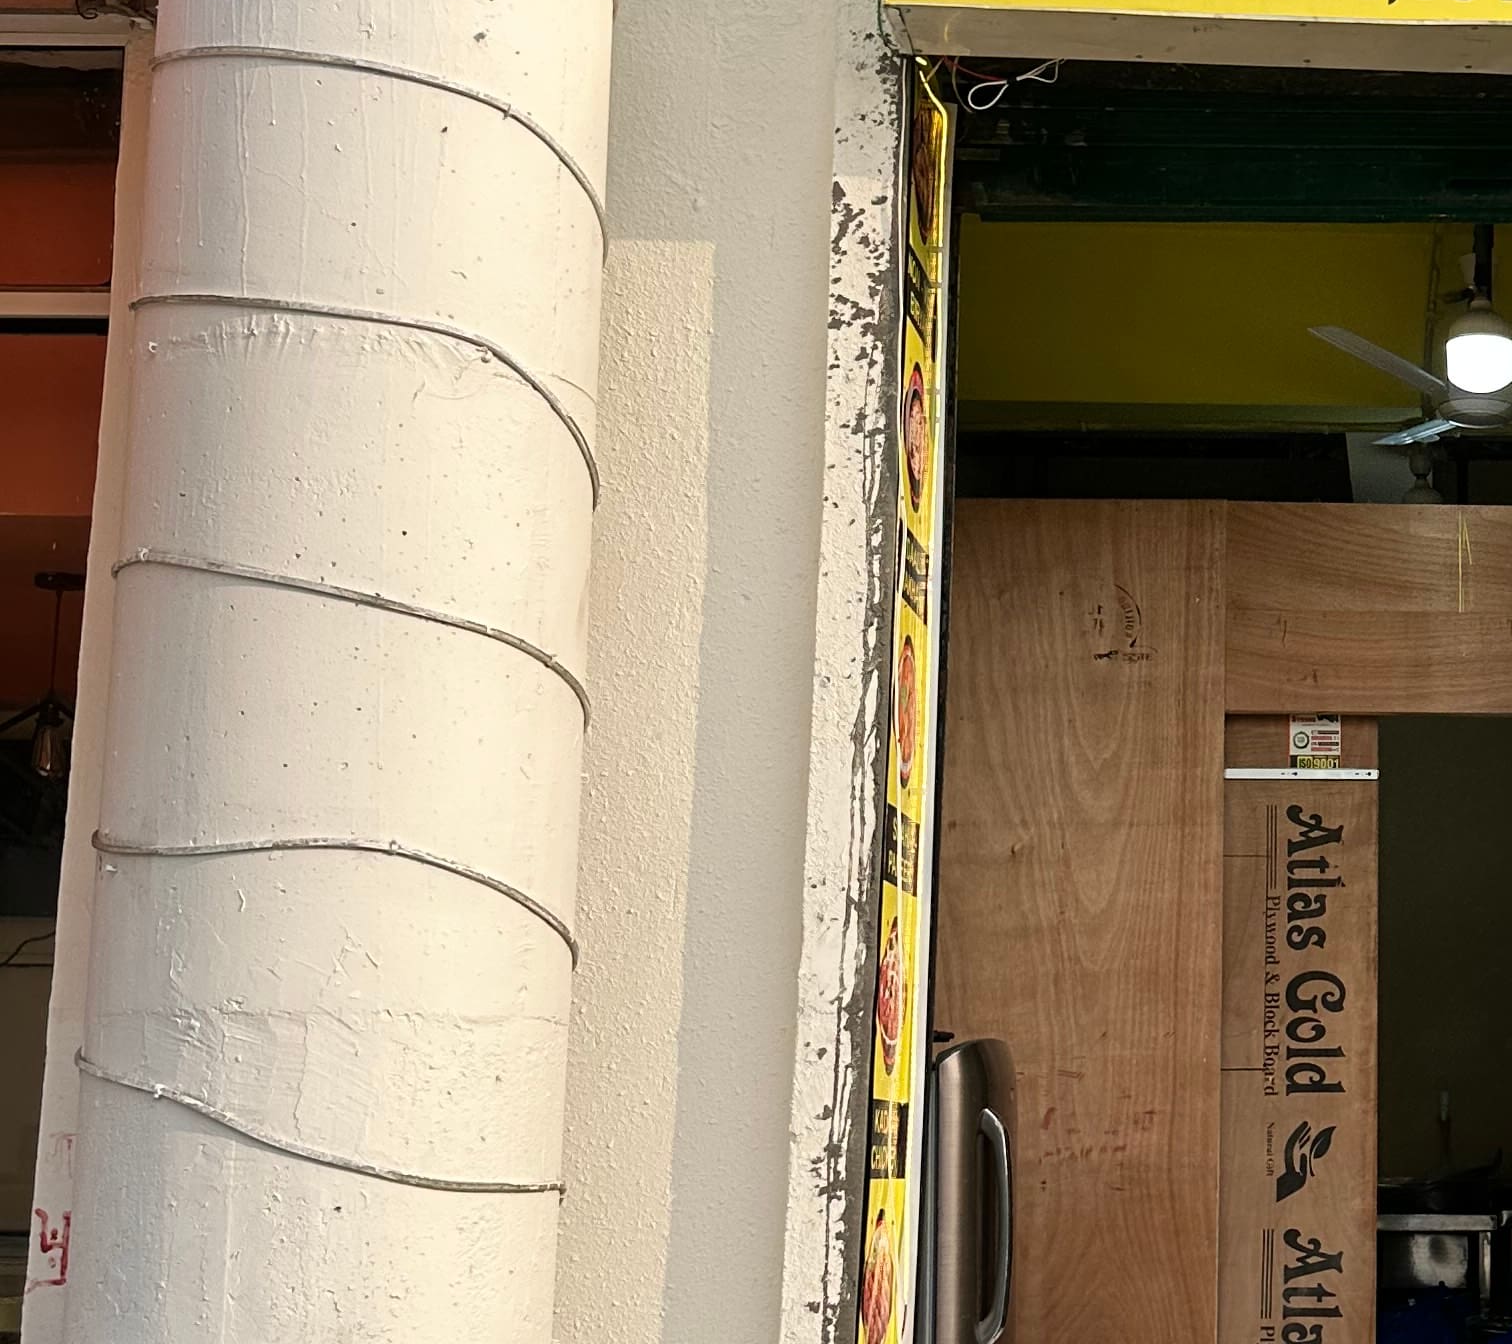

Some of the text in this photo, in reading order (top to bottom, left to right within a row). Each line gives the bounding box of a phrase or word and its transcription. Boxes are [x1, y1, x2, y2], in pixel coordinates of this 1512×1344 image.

[1284, 803, 1346, 952] Atlas
[1263, 894, 1281, 966] Plywood
[1263, 991, 1281, 1040] Block
[1284, 969, 1347, 1098] Gold
[1263, 1043, 1281, 1098] Board
